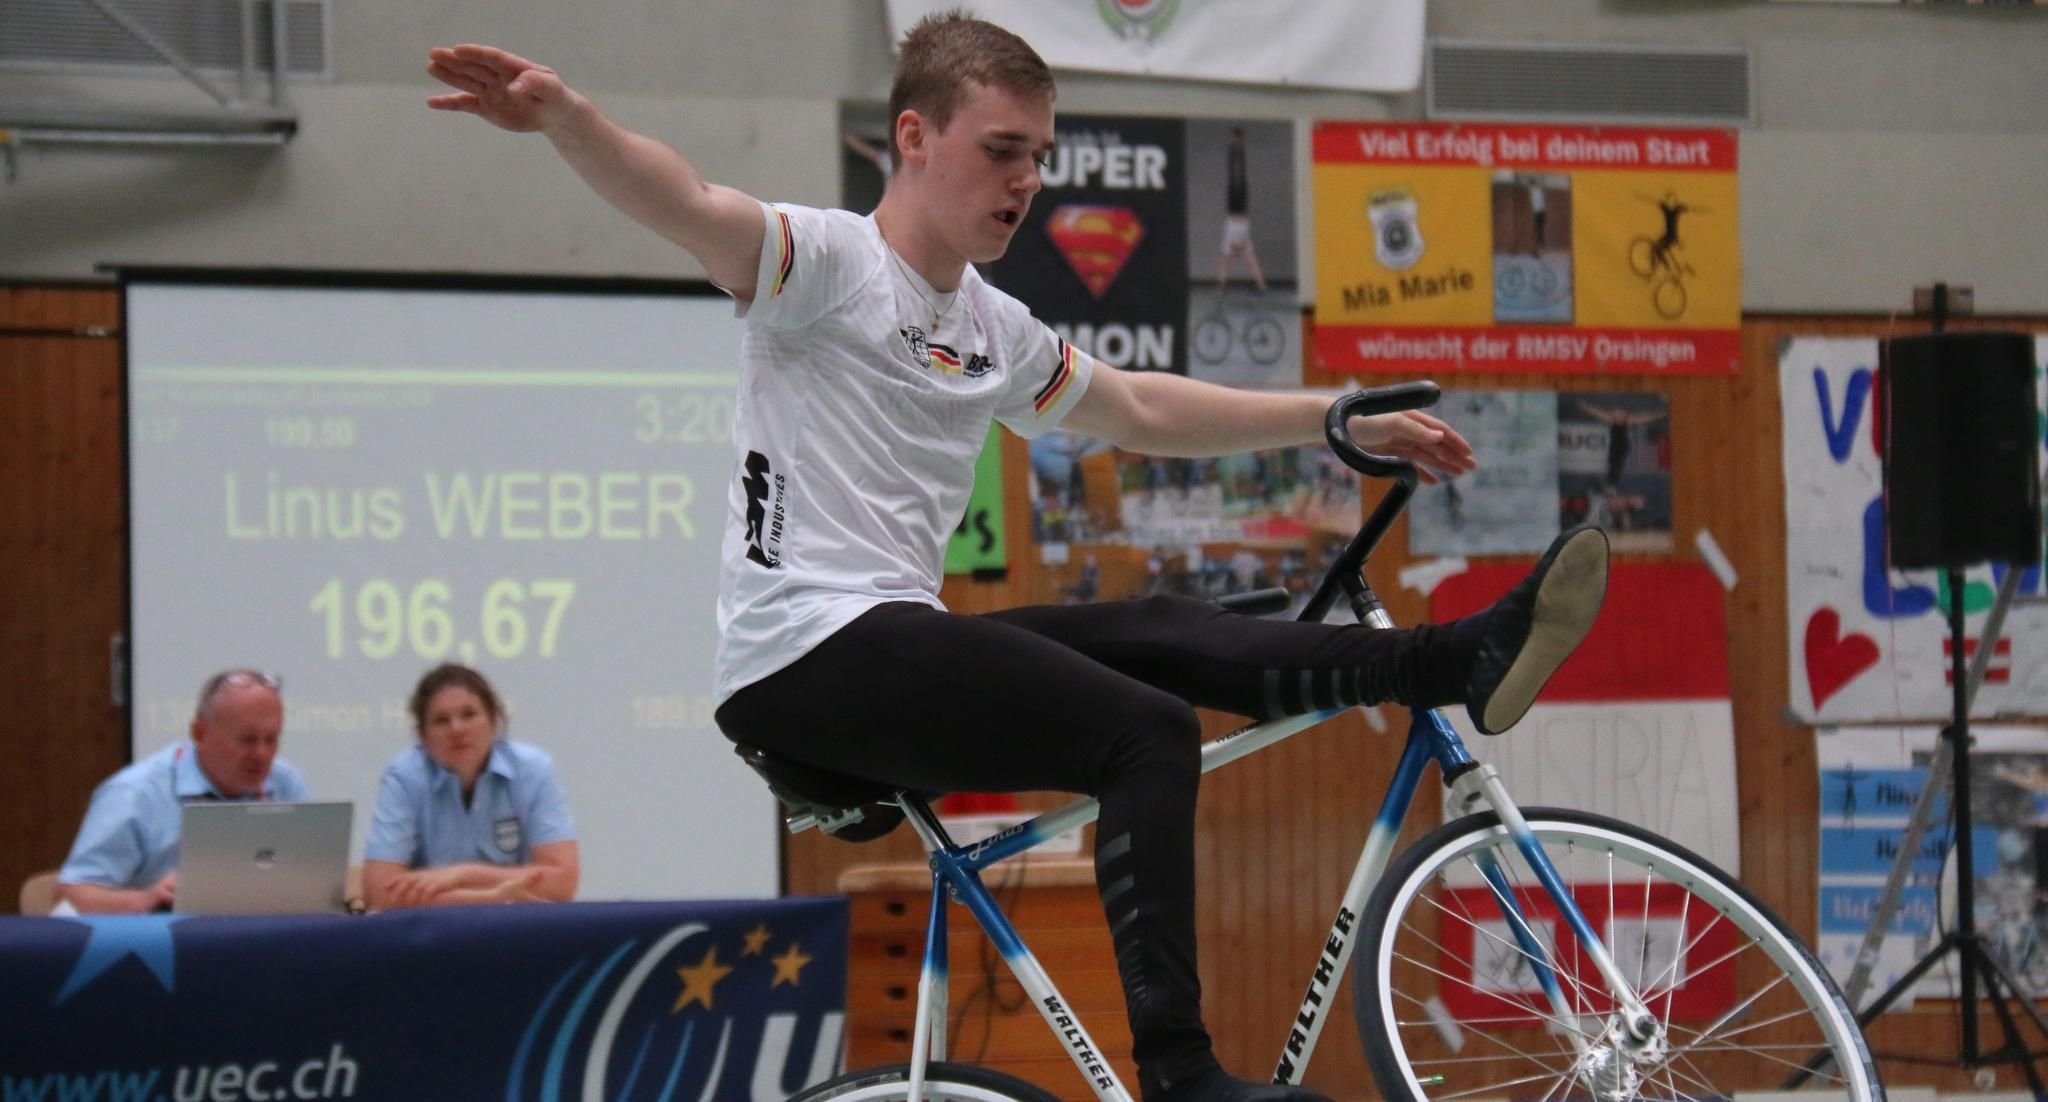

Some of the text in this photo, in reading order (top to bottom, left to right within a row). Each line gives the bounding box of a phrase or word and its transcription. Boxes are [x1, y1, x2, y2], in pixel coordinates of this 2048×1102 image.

[1040, 143, 1168, 189] UPER
[1359, 132, 1711, 166] Viel Erfolg bei deinem Start
[1342, 267, 1475, 313] Mia Marie
[1054, 322, 1174, 369] MON
[1358, 335, 1696, 366] wünscht der RMSV Orsingen
[224, 471, 403, 539] Linus
[425, 472, 696, 539] WEBER
[310, 578, 576, 664] 196,67
[1271, 907, 1356, 1086] WALTHER
[1043, 996, 1114, 1091] WALTHER
[2, 1044, 360, 1102] www.uec.ch
